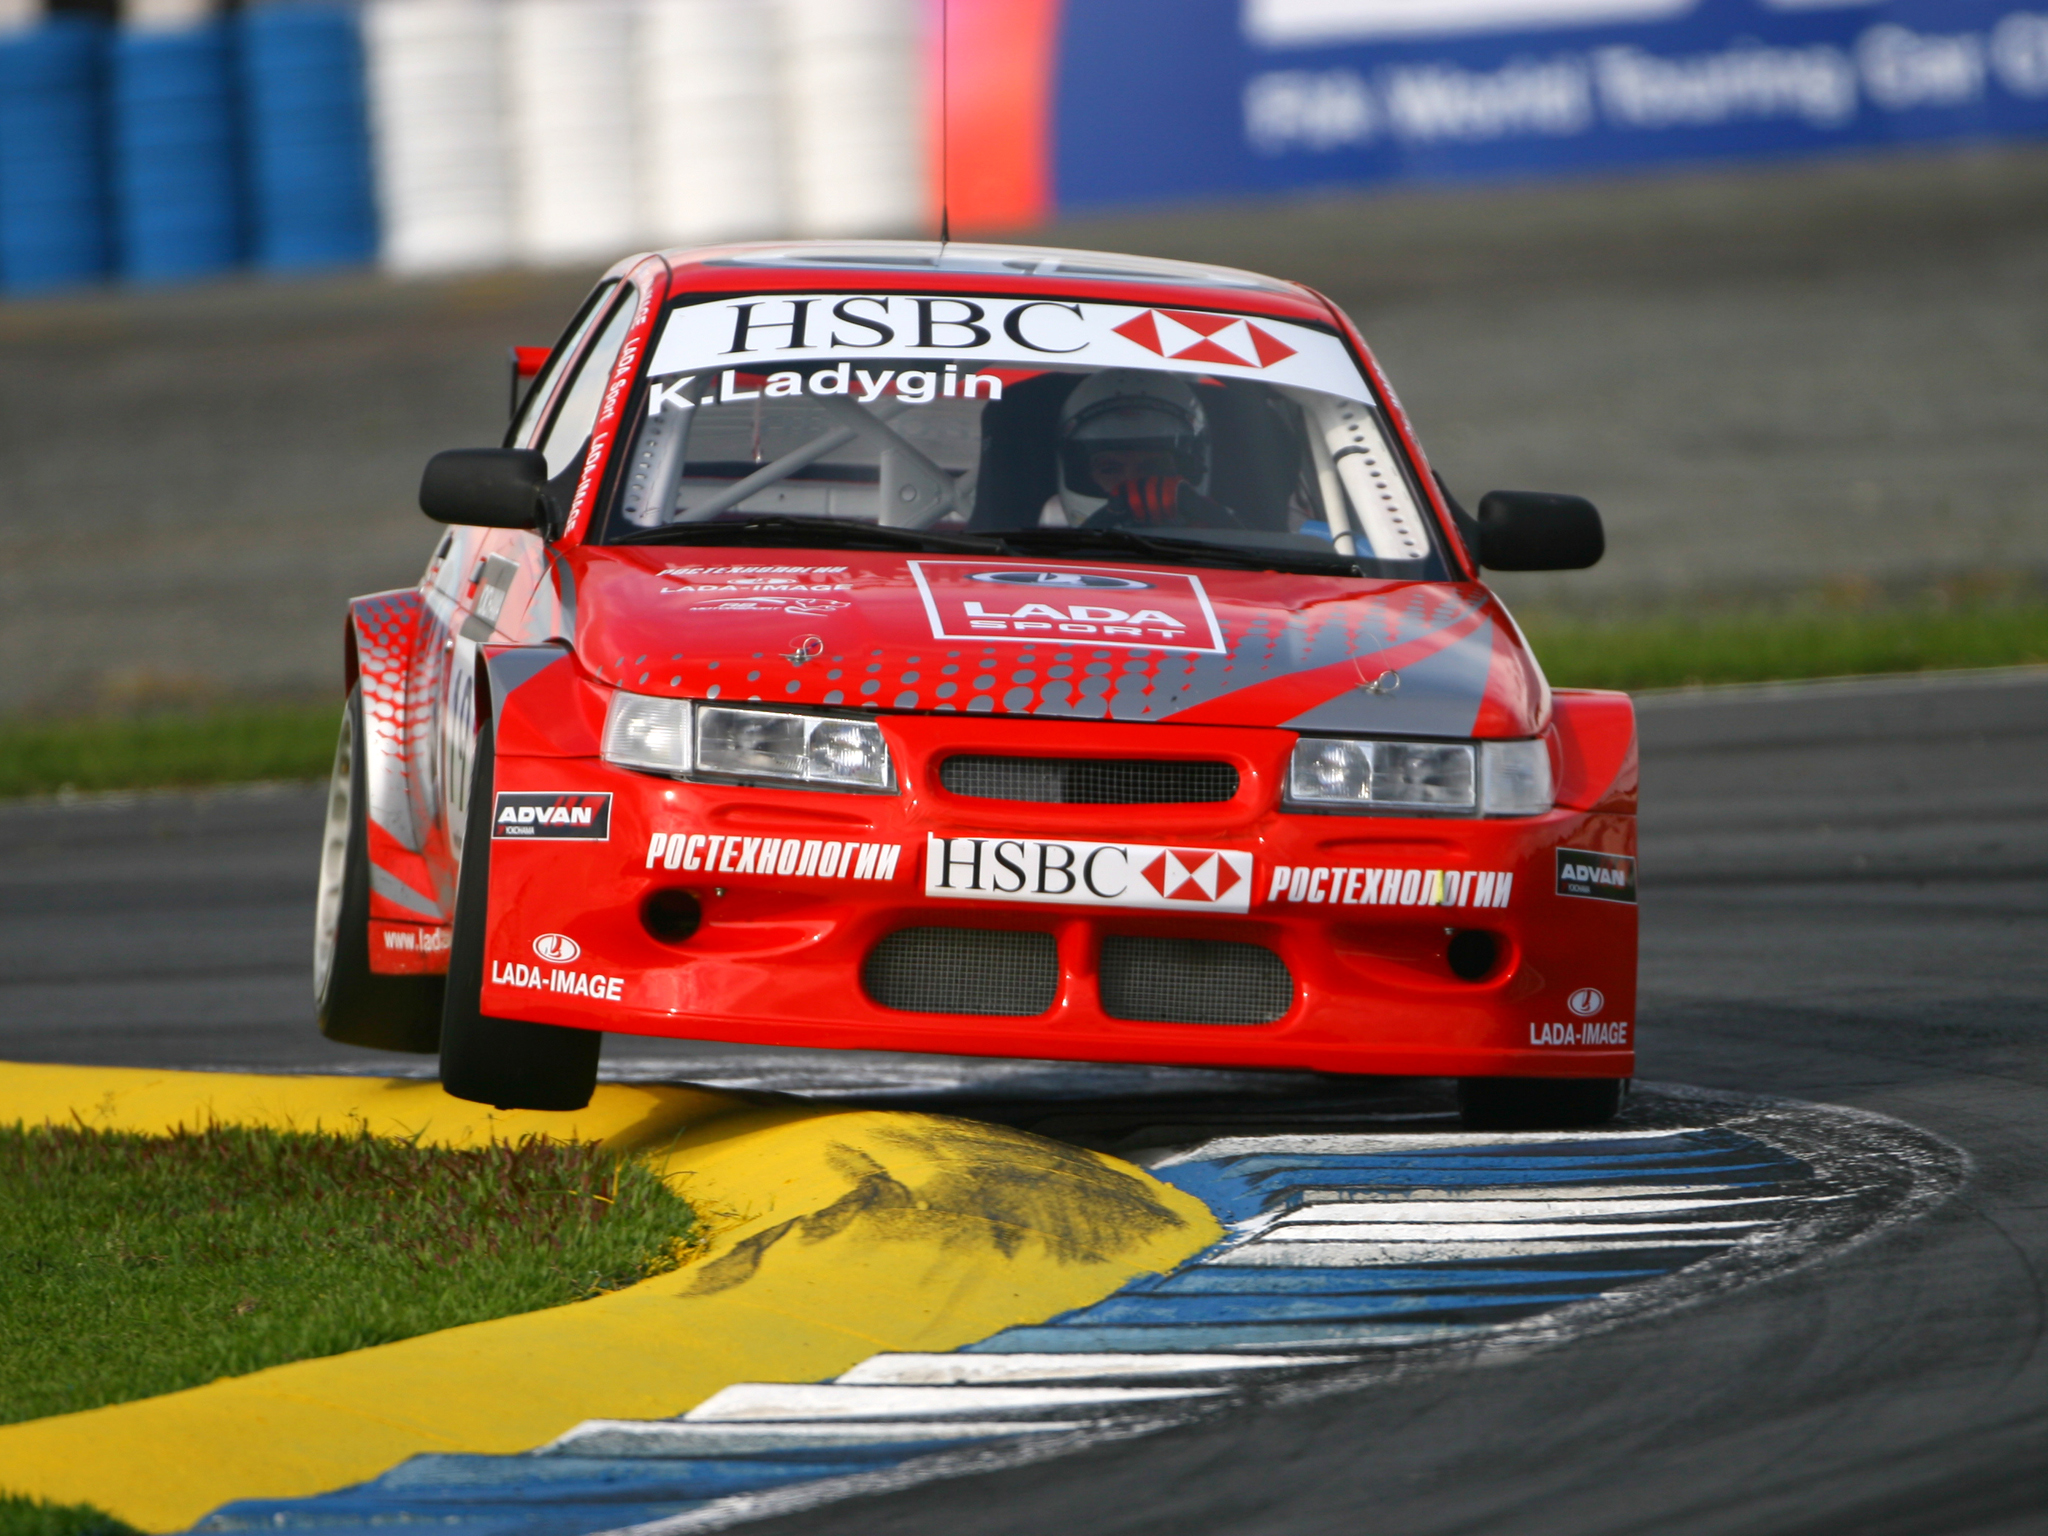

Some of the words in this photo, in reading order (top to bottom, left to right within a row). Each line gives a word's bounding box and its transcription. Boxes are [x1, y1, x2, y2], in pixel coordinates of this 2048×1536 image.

[1387, 58, 1594, 142] World
[1596, 42, 1860, 128] Touring
[1854, 22, 1986, 108] Car
[717, 296, 1090, 354] HSBC
[614, 337, 640, 379] LADA
[599, 378, 627, 423] Sport
[648, 362, 1003, 416] K.Ladygin
[563, 432, 609, 539] LADA-IMAGE
[660, 583, 854, 594] LADA-IMAGE
[963, 601, 1187, 628] LADA
[969, 619, 1186, 639] SPORT
[497, 806, 593, 824] ADVAN
[645, 832, 902, 881] РОСТЕХНОЛОГИИ
[935, 838, 1129, 899] HSBC
[1561, 863, 1626, 888] ADVAN
[1267, 865, 1514, 909] РОСТЕХНОЛОГИИ
[491, 959, 625, 1001] LADA-IMAGE
[1530, 1021, 1628, 1046] LADA-IMAGE
